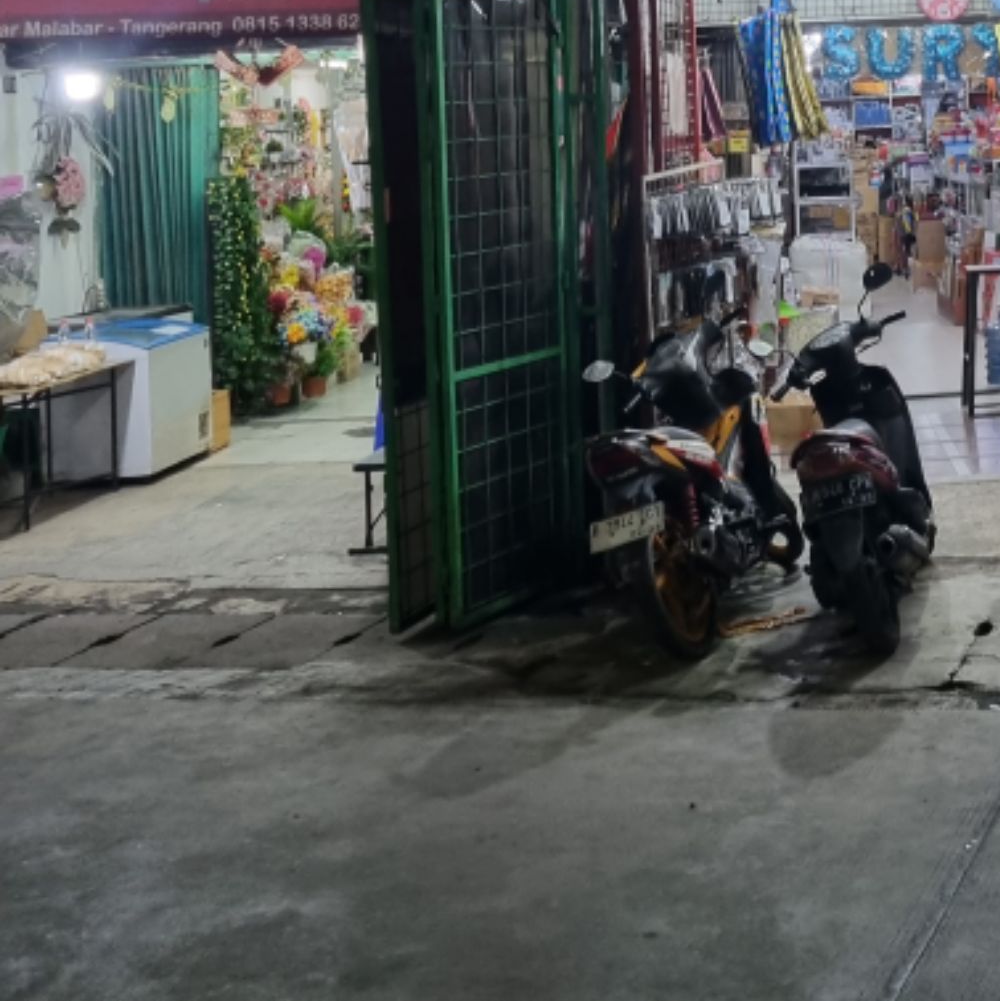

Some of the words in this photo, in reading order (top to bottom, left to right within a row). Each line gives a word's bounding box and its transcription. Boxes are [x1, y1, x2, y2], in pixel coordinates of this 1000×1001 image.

[23, 21, 103, 37] Malabar
[120, 18, 222, 37] Tangerang
[232, 16, 279, 32] 0815
